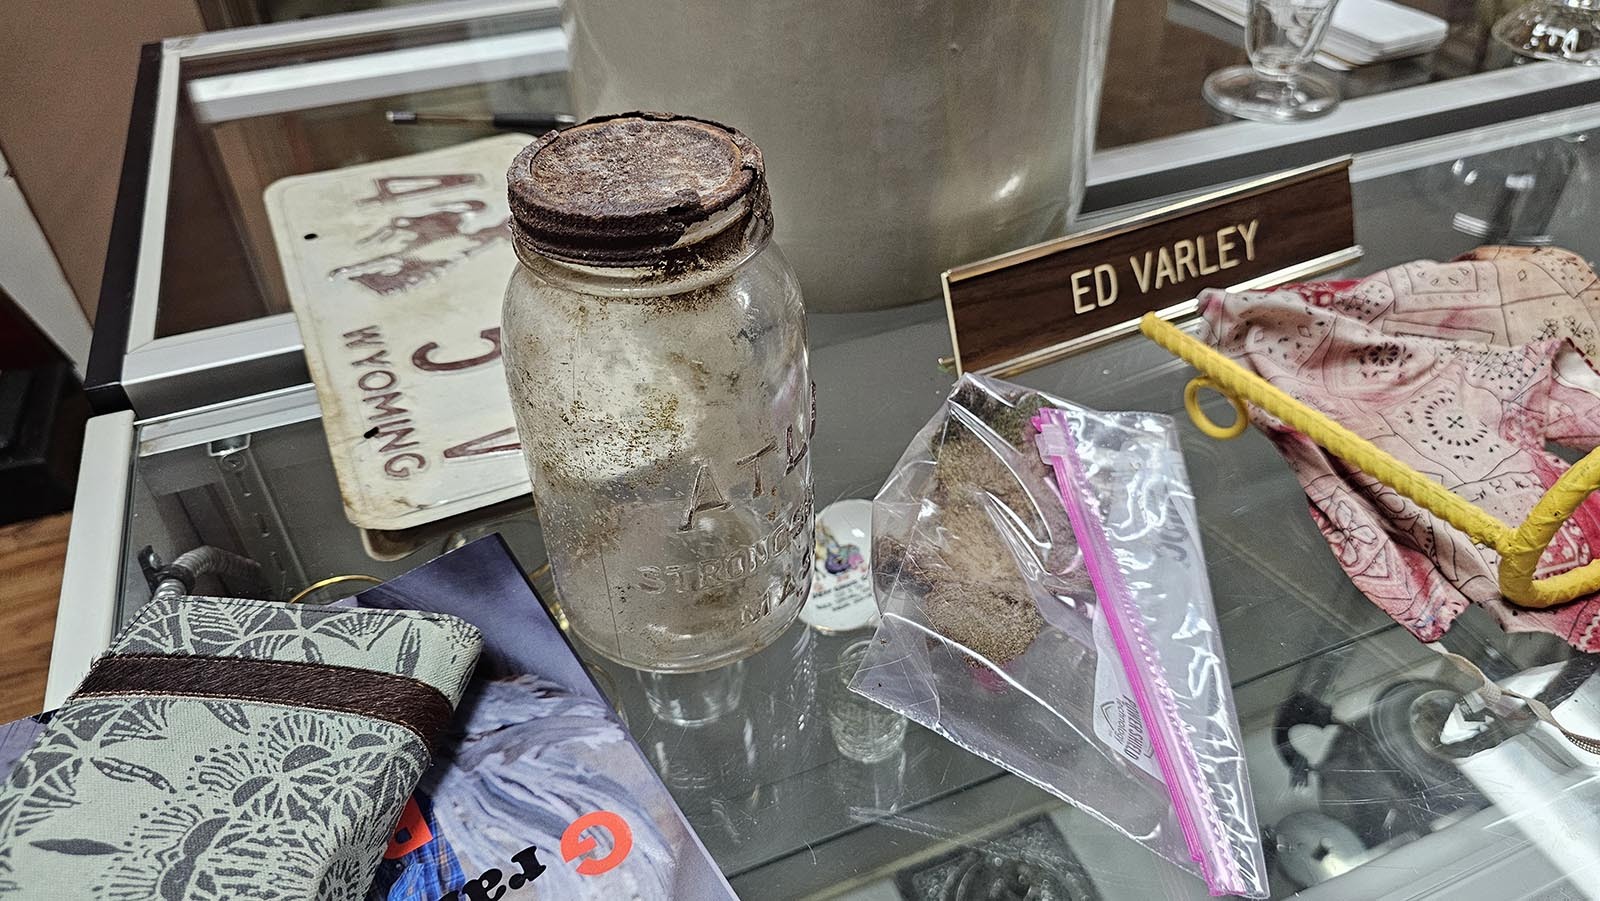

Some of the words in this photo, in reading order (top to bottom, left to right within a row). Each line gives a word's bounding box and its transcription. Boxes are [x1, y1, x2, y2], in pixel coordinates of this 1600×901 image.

[1070, 263, 1119, 315] ED
[1129, 218, 1260, 294] VARLEY
[342, 323, 427, 479] WYOMING
